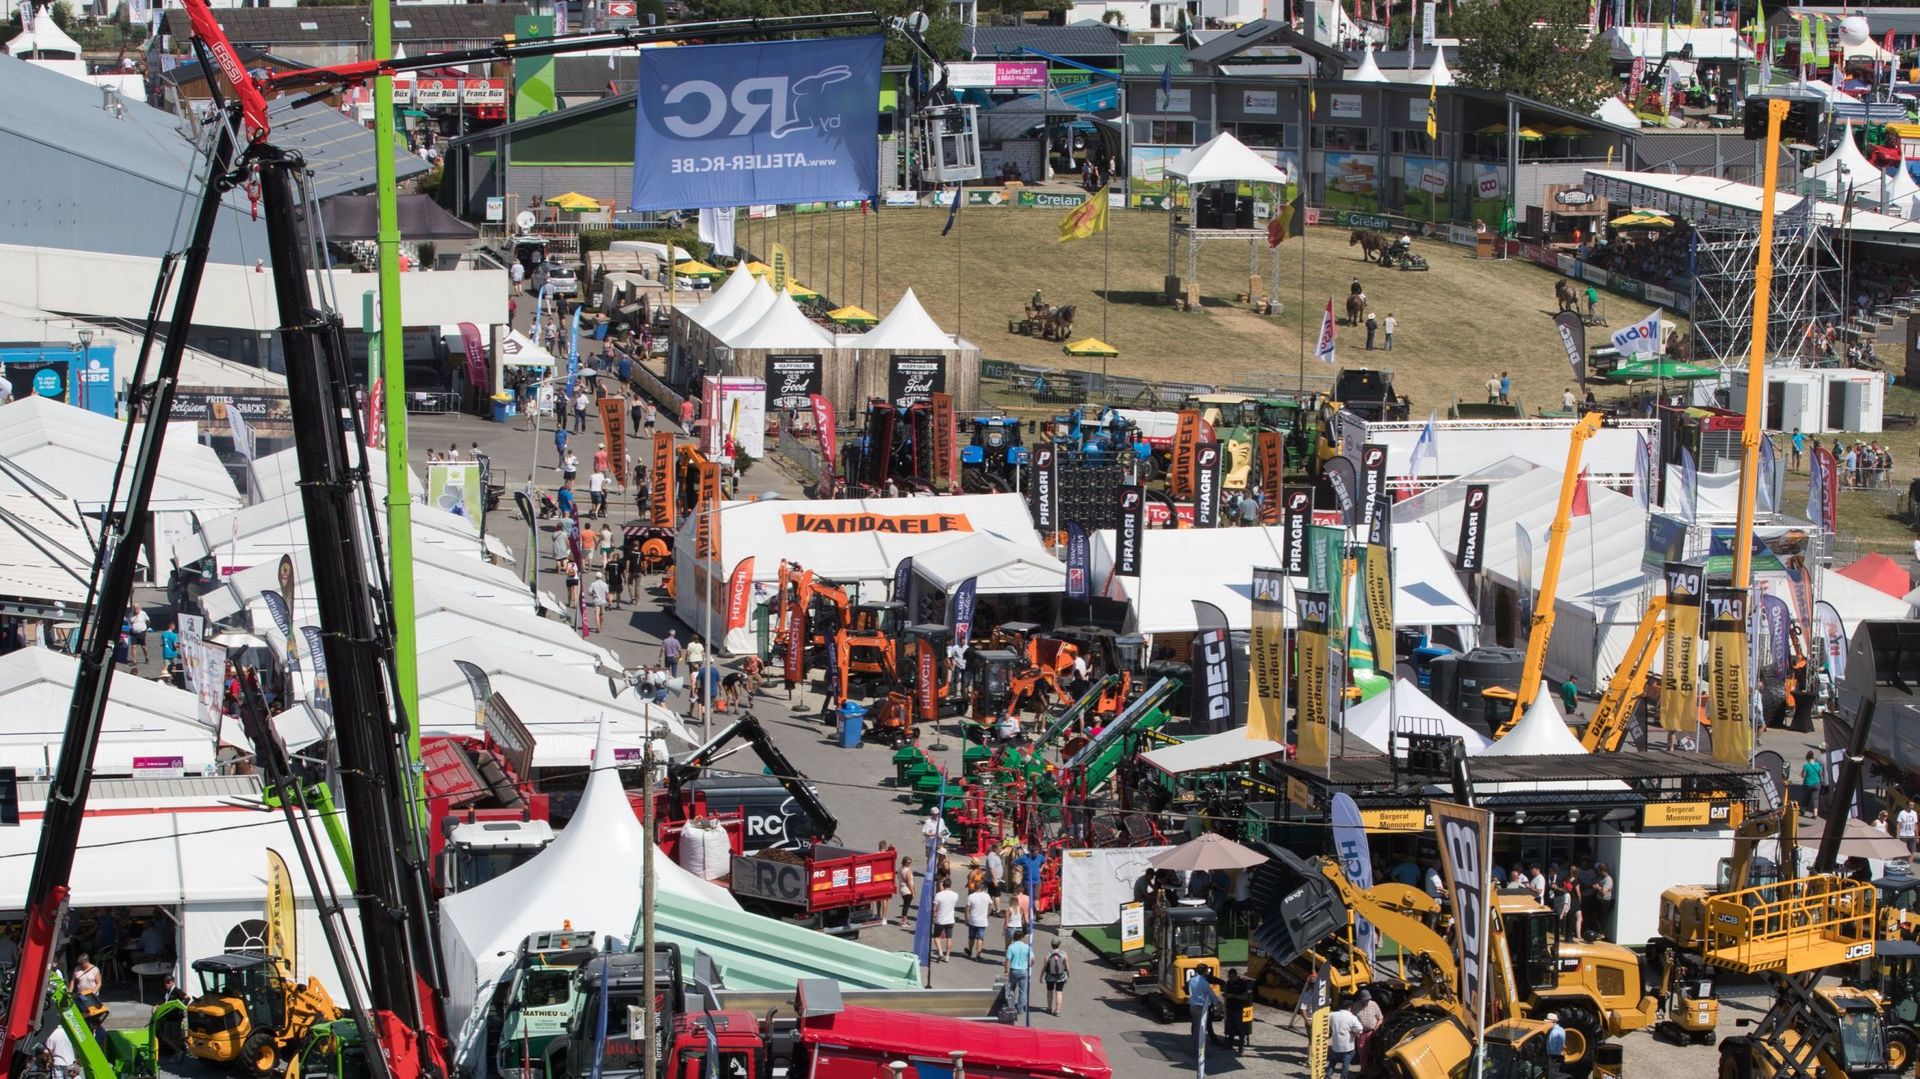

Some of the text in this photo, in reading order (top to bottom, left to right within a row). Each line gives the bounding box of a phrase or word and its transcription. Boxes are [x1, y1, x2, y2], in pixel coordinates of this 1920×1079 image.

[214, 44, 241, 82] FASSI
[419, 90, 440, 98] Franz
[466, 90, 486, 98] Franz
[1036, 195, 1082, 206] Crelan
[1350, 213, 1389, 229] Crelan
[780, 379, 810, 393] Food
[904, 379, 934, 393] Food
[206, 395, 234, 404] FRITES
[170, 400, 207, 417] Belgium
[237, 403, 267, 414] SNACKS
[1038, 470, 1049, 526] PIRAGRI
[1200, 469, 1212, 524] PIRAGRI
[797, 513, 960, 534] VANDAELE
[1122, 513, 1135, 572] PIRAGRI
[1290, 514, 1303, 572] PIRAGRI
[1463, 511, 1479, 569] PIRAGRI
[731, 571, 747, 621] HITACHI
[957, 591, 966, 621] ELSEN
[1203, 628, 1231, 721] DIECI
[1591, 705, 1612, 737] DIECI
[1380, 812, 1410, 821] Bergerat
[1666, 806, 1695, 814] Bergerat
[1666, 814, 1703, 822] Monnoyeur
[1711, 806, 1731, 819] CAT
[748, 814, 784, 837] RC
[1379, 821, 1418, 829] Monnoyeur
[757, 862, 801, 901] RC
[813, 870, 826, 879] RC
[1446, 821, 1480, 1005] JCB
[1717, 914, 1738, 926] JCB
[1845, 943, 1873, 960] JCB
[1318, 979, 1327, 1007] CAT
